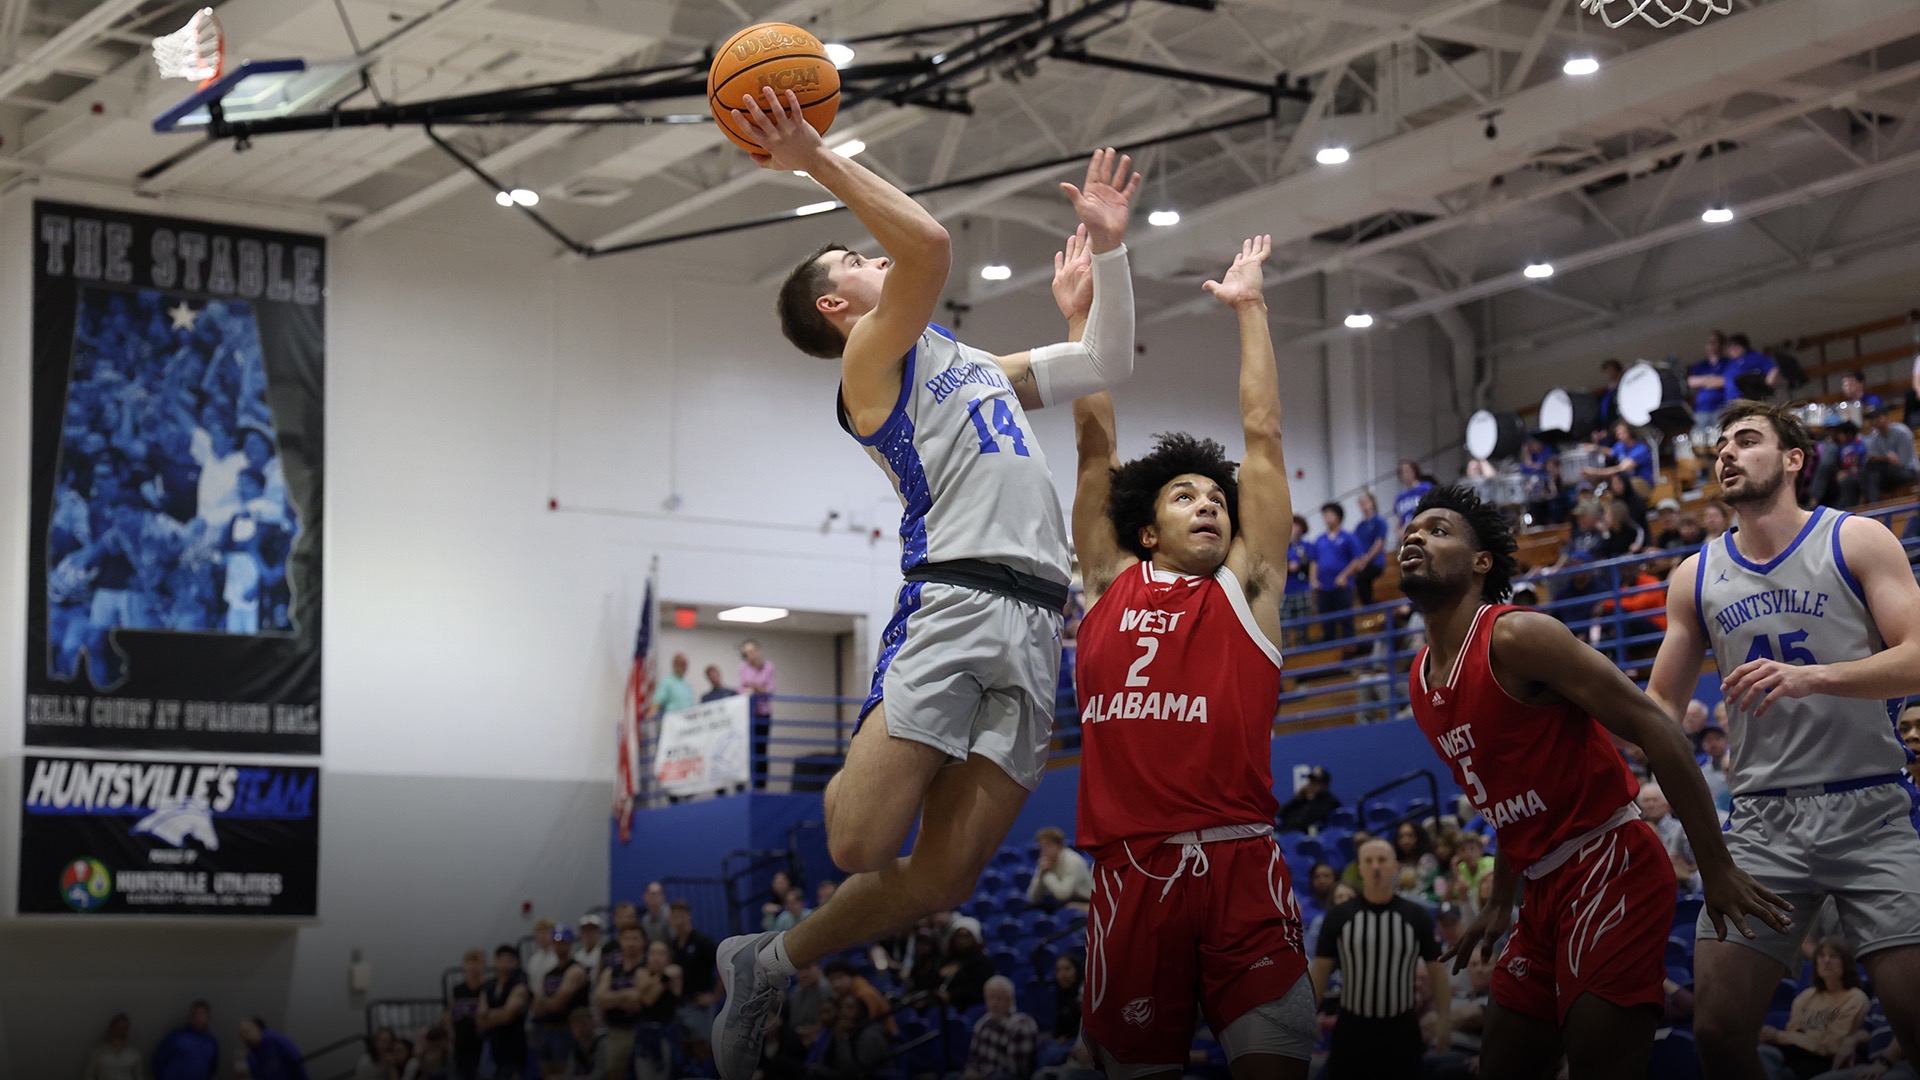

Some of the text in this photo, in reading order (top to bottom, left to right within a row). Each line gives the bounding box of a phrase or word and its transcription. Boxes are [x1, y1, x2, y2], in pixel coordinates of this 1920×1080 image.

[730, 30, 824, 62] Wilson
[757, 66, 820, 97] NCAA
[41, 214, 321, 305] THE STABLE
[967, 398, 1030, 457] 14
[1119, 607, 1185, 634] WEST
[1715, 589, 1829, 636] HUNTSVILLE
[1125, 636, 1159, 687] 2
[1744, 628, 1818, 672] 45
[28, 694, 88, 726] KELLY
[154, 700, 180, 730] AT
[1081, 692, 1208, 723] ALABAMA
[1437, 723, 1476, 759] WEST
[26, 760, 315, 817] HUNTSVILLE'S TEAM
[1458, 755, 1488, 805] 5
[1476, 789, 1548, 830] BAMA
[116, 871, 283, 895] HUNTSVILLE UTILITIES
